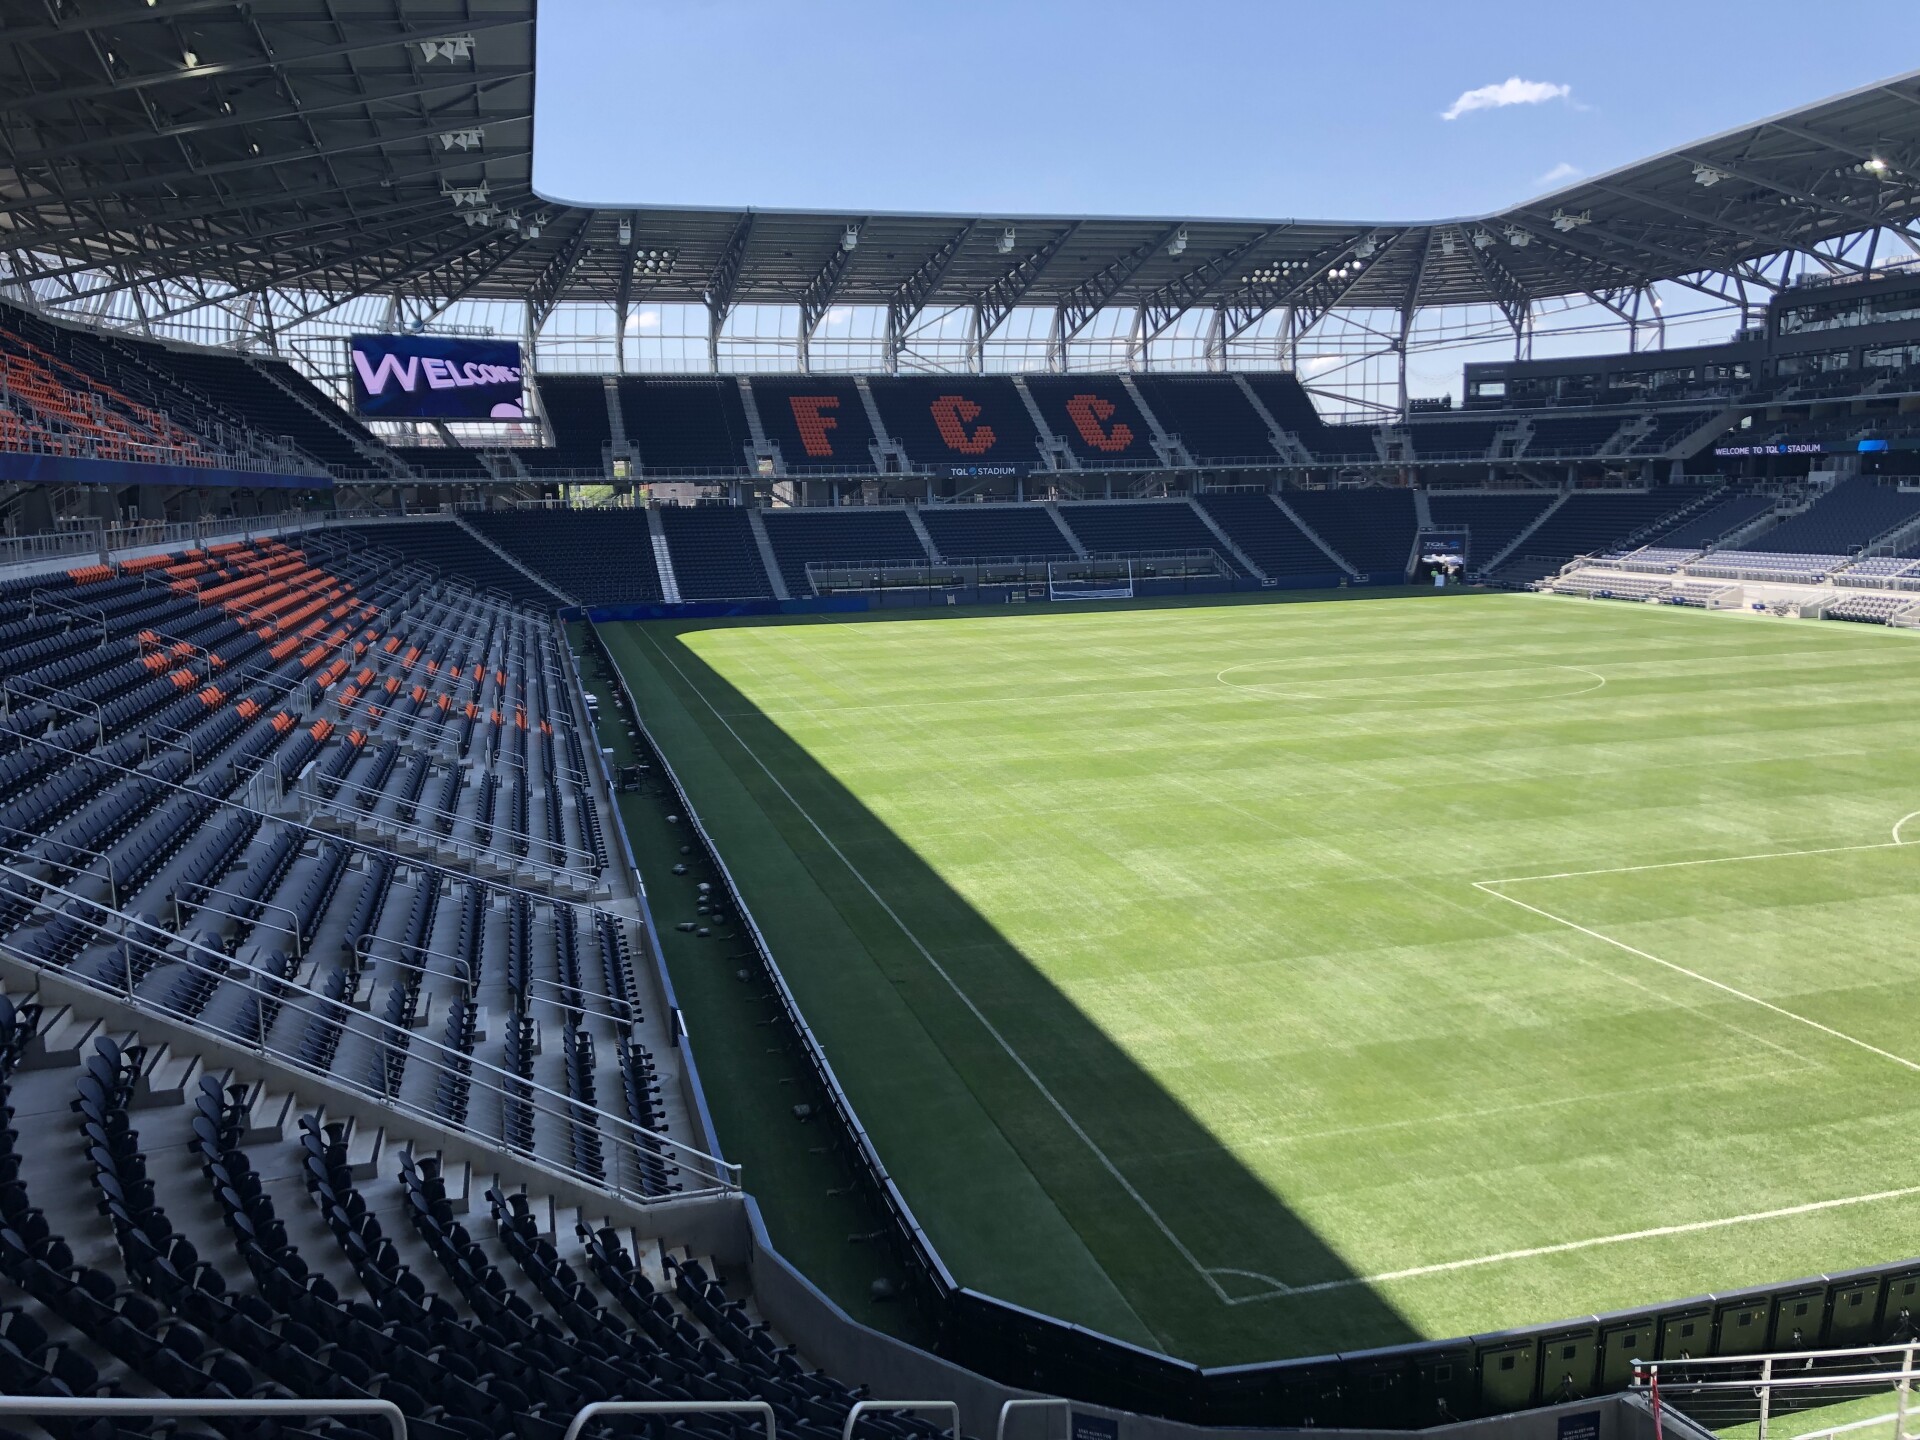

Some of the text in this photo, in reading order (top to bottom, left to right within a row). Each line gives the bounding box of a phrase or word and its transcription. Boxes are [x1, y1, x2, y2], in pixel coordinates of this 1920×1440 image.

[353, 350, 520, 395] WELCOME
[1715, 444, 1821, 455] WELCOME TO TQL STADIUM
[951, 467, 1016, 476] TQL STADIUM
